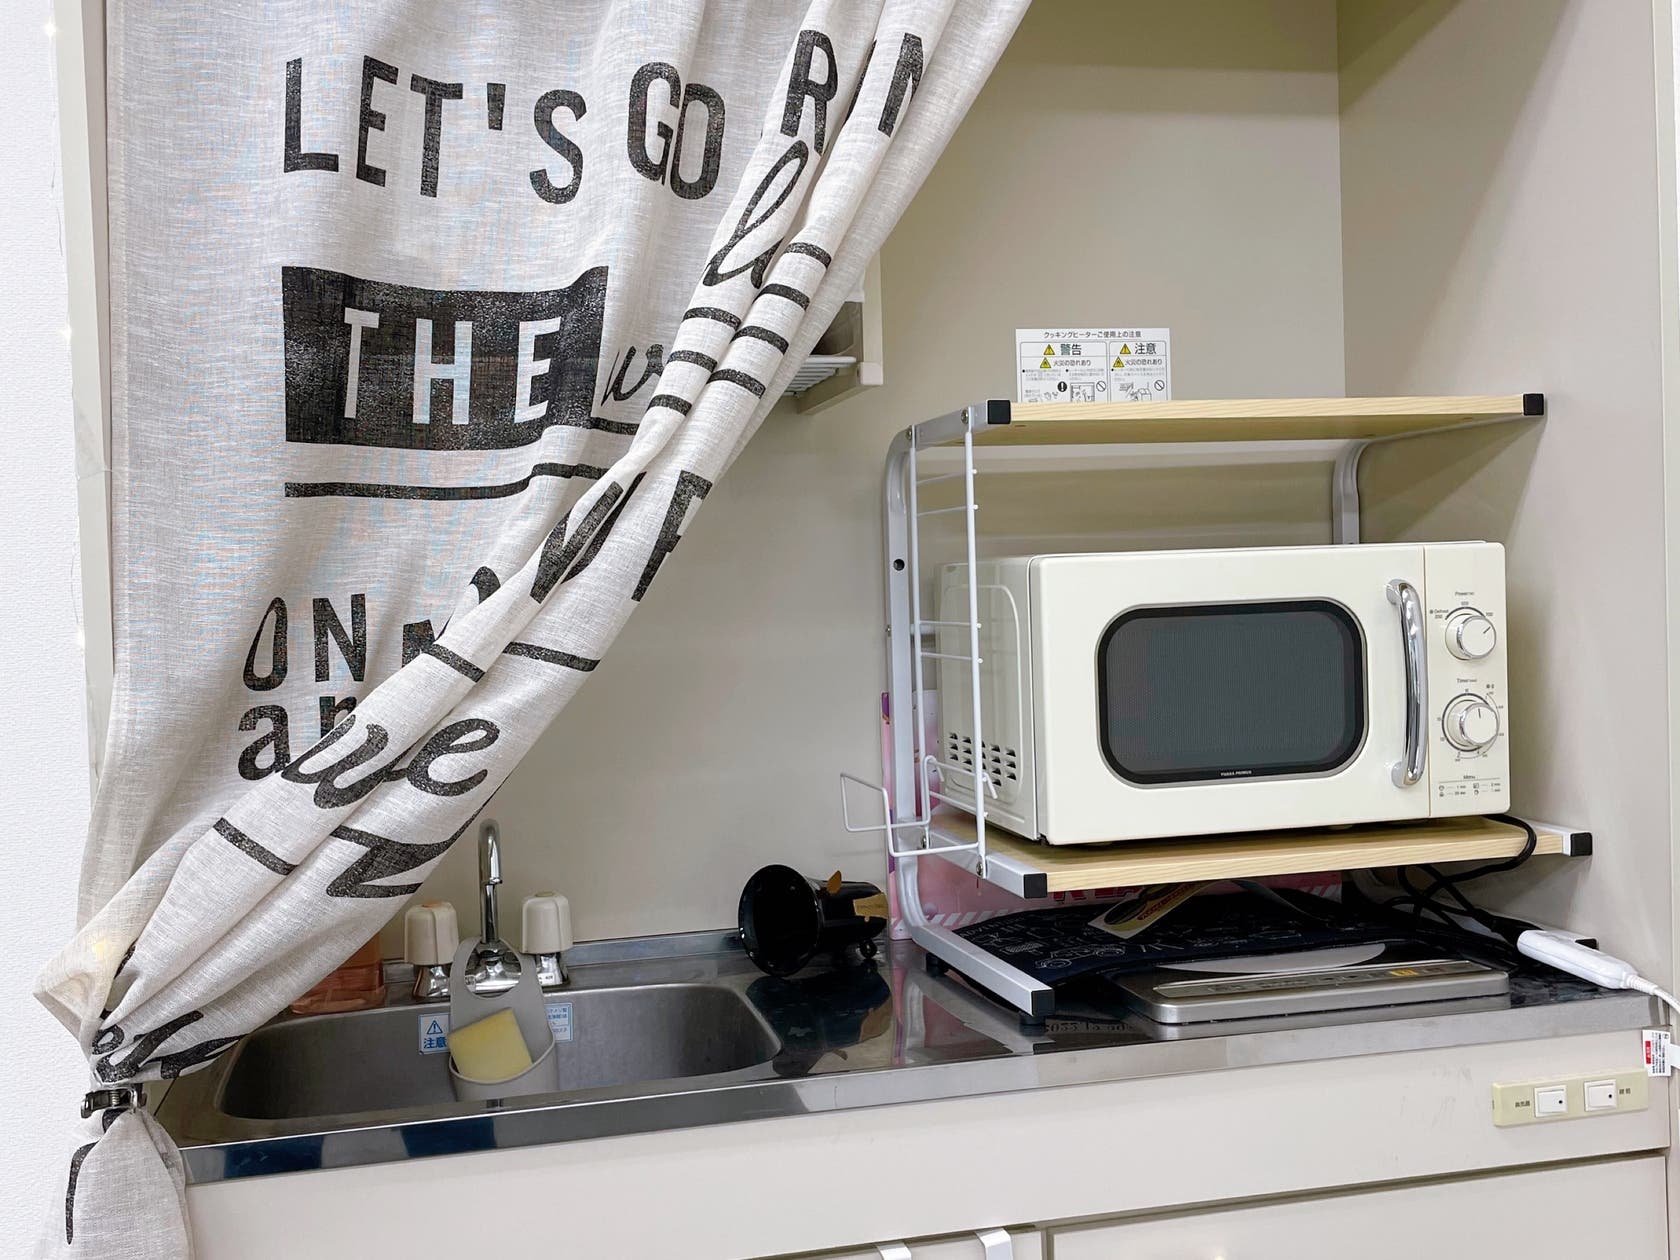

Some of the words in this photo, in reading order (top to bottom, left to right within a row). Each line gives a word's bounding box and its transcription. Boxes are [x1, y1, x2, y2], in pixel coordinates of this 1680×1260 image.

[284, 55, 587, 204] LET'S
[627, 62, 725, 200] GO
[343, 308, 562, 426] THE
[1060, 343, 1082, 356] 警告
[1134, 342, 1157, 355] 注意
[243, 593, 367, 692] ON
[423, 1036, 447, 1049] 注意
